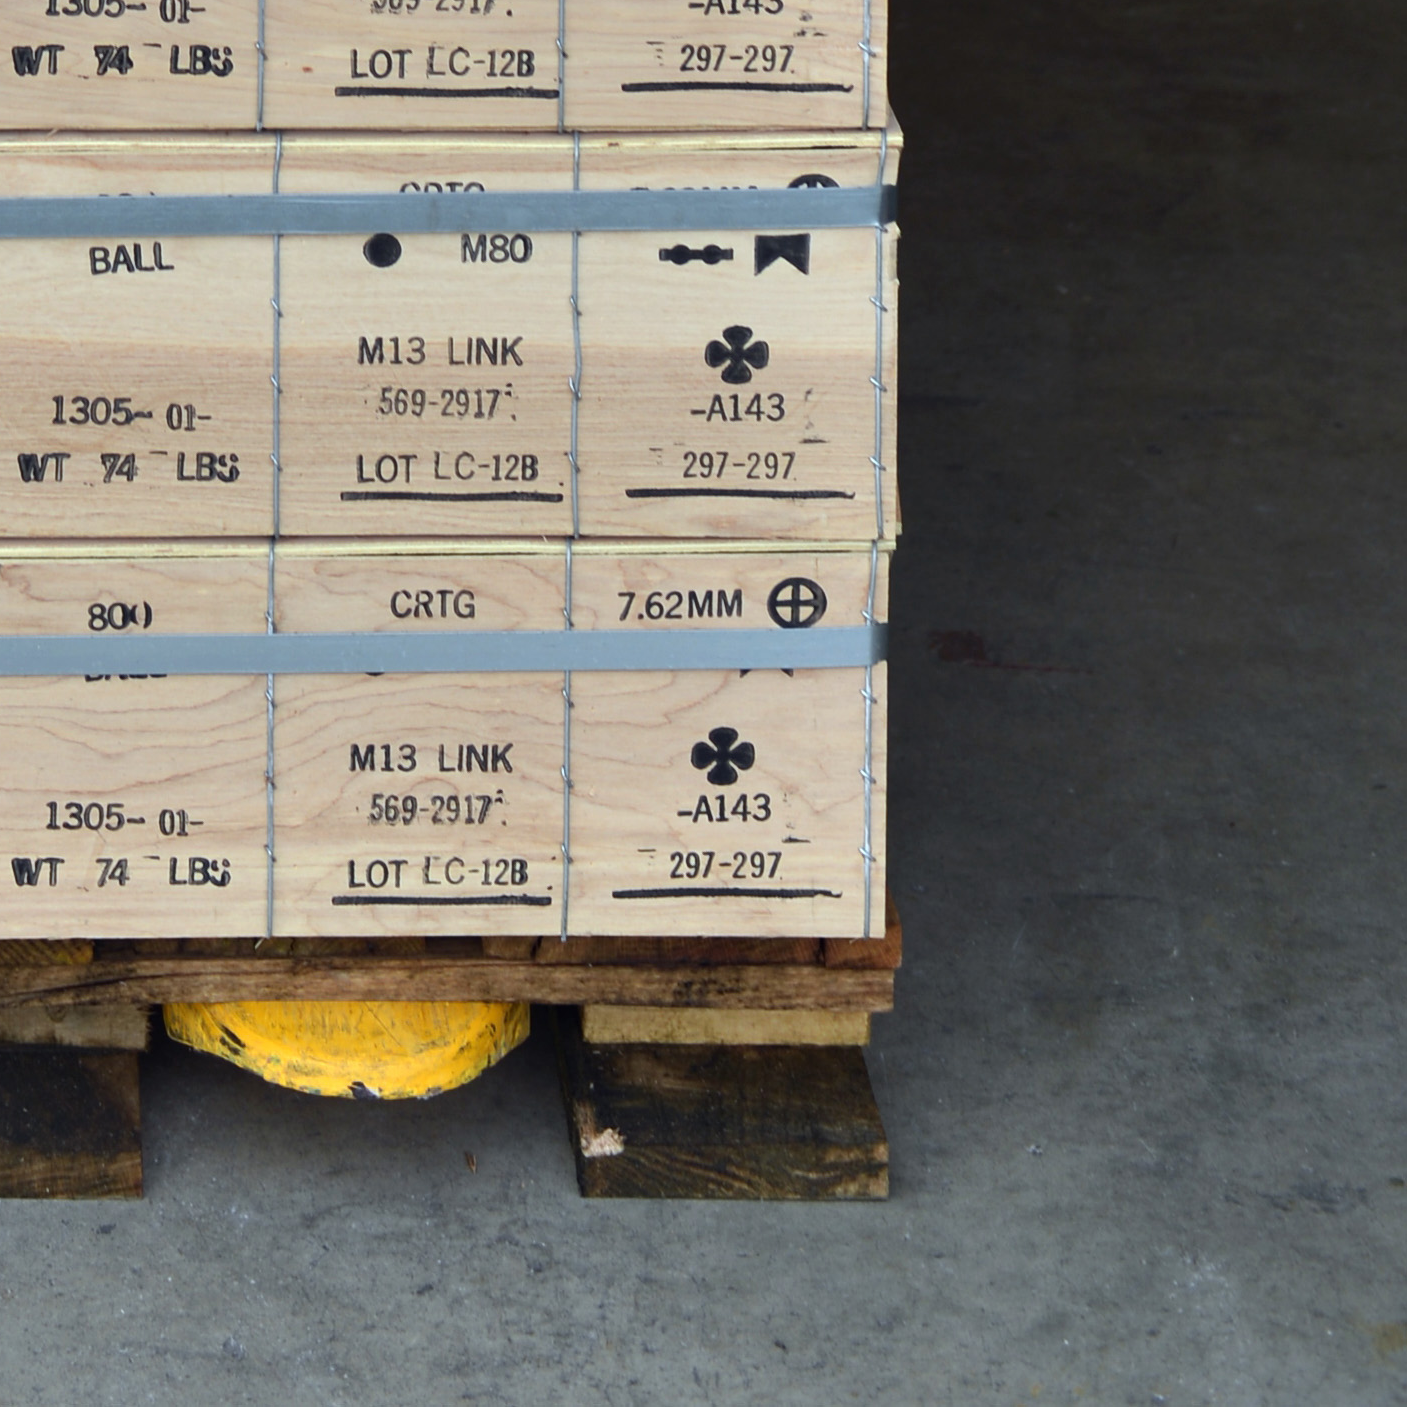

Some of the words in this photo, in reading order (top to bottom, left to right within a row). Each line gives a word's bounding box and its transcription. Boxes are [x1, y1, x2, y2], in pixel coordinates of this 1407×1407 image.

[12, 44, 65, 76] WT
[94, 45, 133, 76] 74
[351, 49, 412, 79] LOT
[427, 46, 535, 78] LC-12B
[680, 44, 794, 72] 297-297
[89, 241, 174, 275] BALL
[461, 233, 531, 263] M80
[358, 337, 425, 365] M13
[448, 337, 523, 366] LINK
[17, 453, 71, 483] WT
[101, 453, 138, 483] 74
[357, 454, 417, 483] LOT
[434, 452, 538, 481] LC-12B
[683, 451, 795, 479] 297-297
[88, 601, 152, 631] 800
[391, 589, 475, 618] CRTG
[618, 589, 742, 621] 7.62MM
[350, 744, 416, 772] M13
[439, 743, 513, 773] LINK
[11, 857, 65, 887] WT
[96, 859, 129, 887] 74
[348, 860, 408, 888] LOT
[422, 856, 528, 885] LC-12B
[670, 851, 782, 879] 297-297
